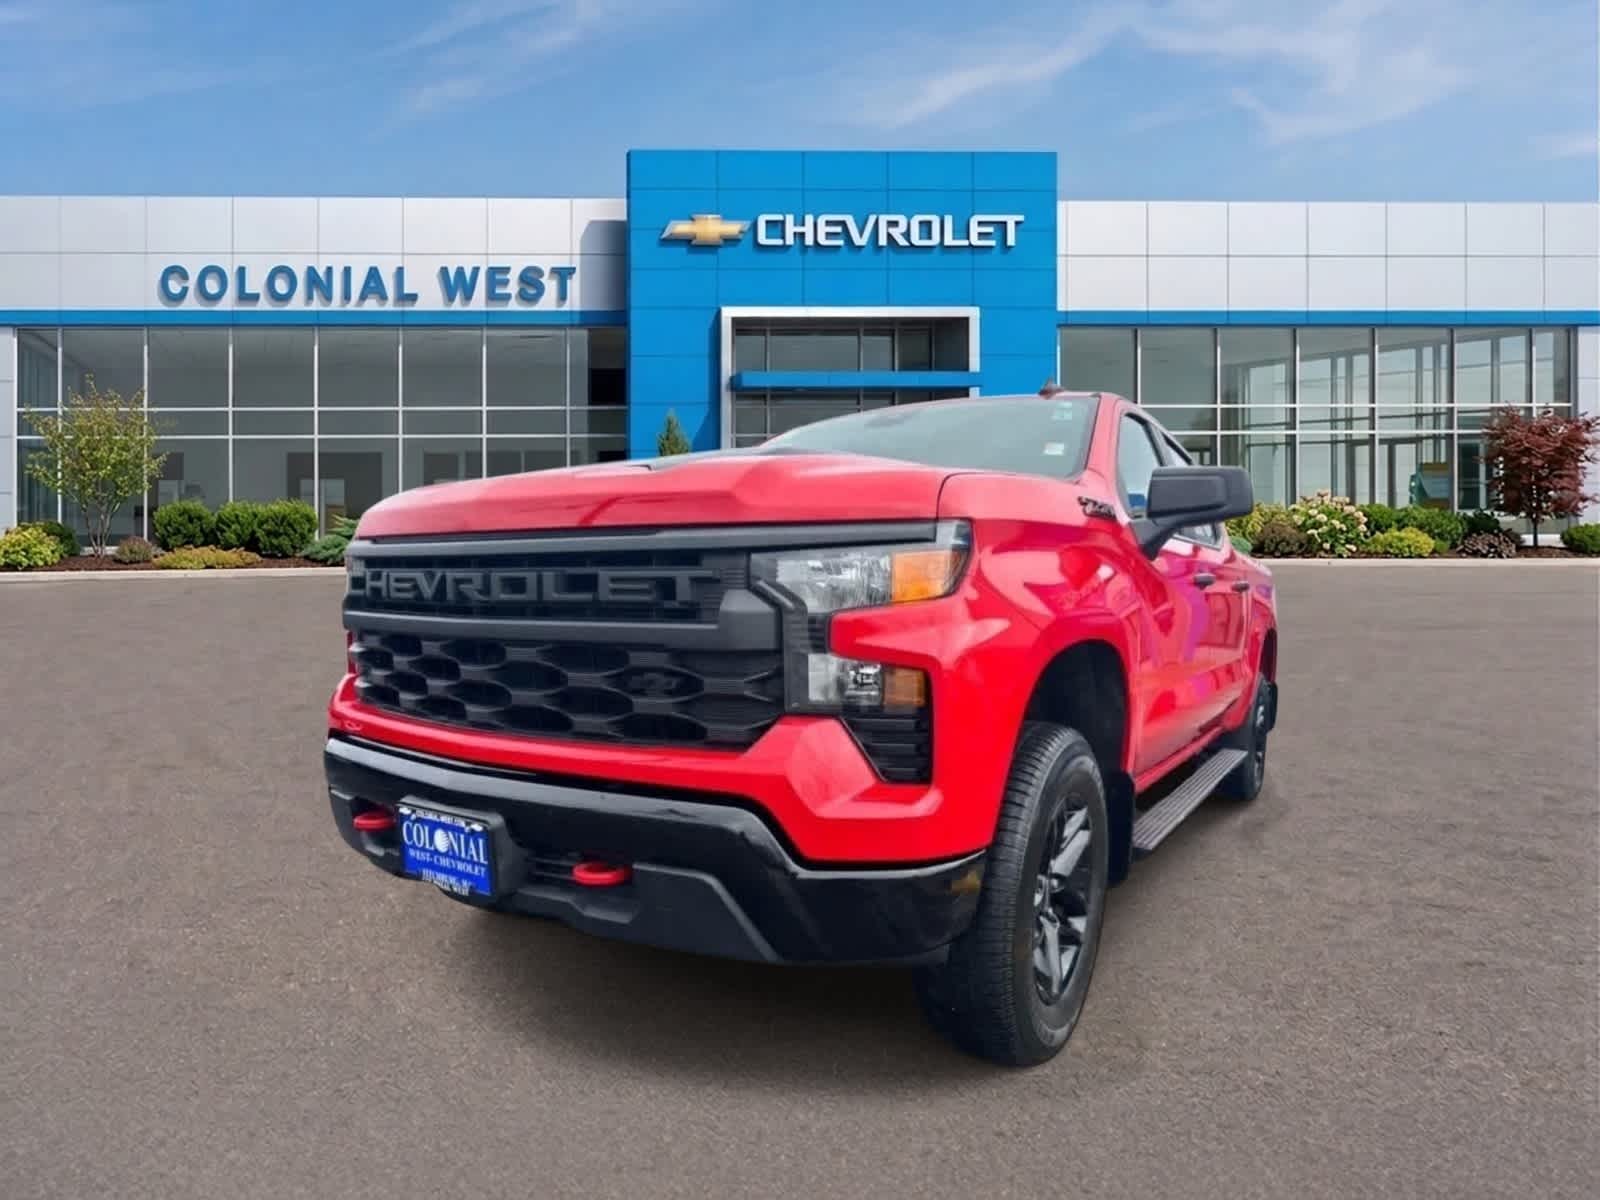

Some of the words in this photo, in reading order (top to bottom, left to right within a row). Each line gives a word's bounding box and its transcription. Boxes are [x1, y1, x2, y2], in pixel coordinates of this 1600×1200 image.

[757, 213, 1025, 247] CHEVROLET
[160, 264, 418, 303] COLONIAL
[438, 265, 577, 303] WEST
[347, 567, 716, 607] CHEVROLET
